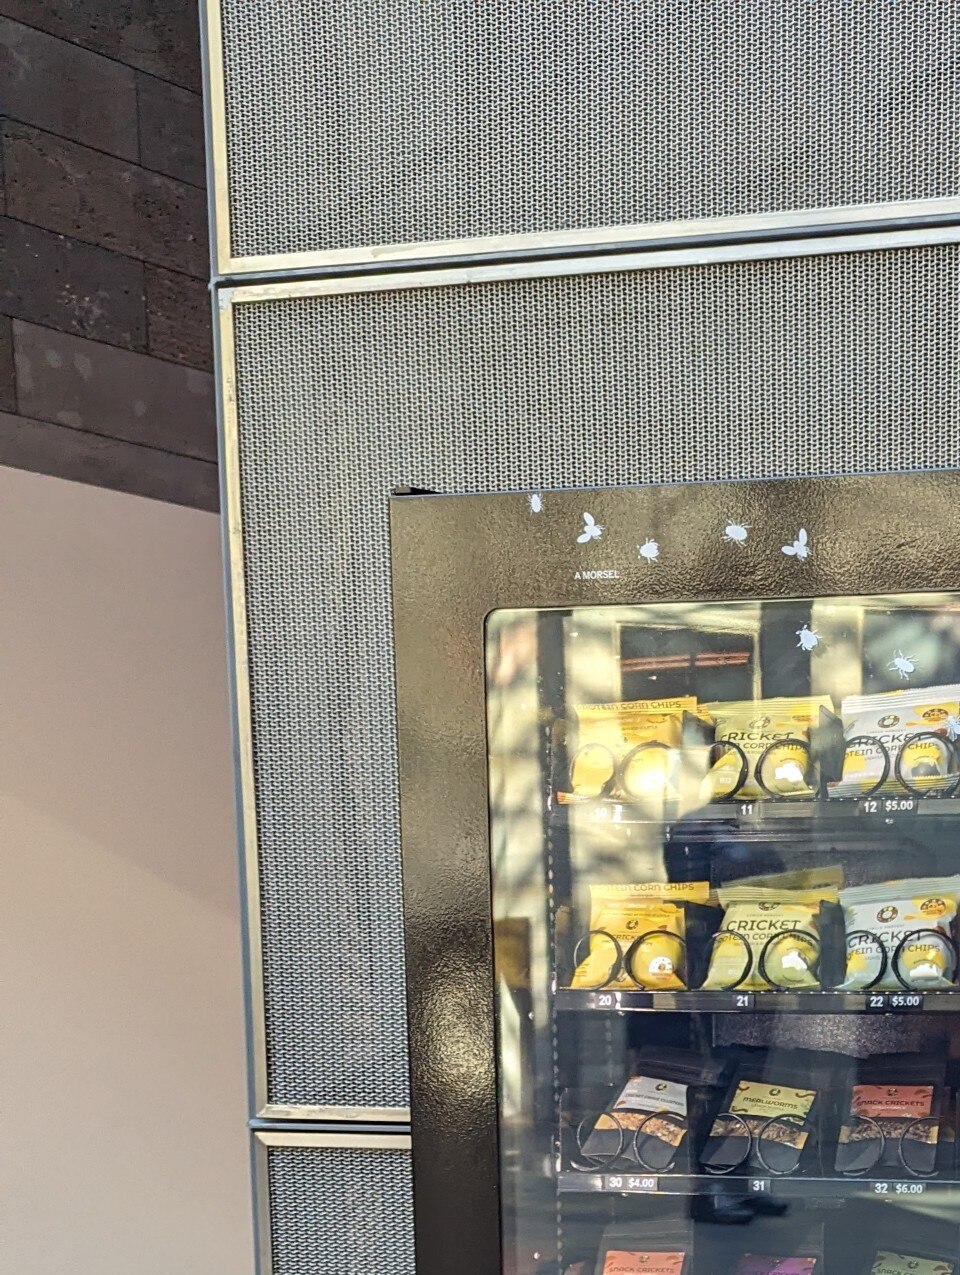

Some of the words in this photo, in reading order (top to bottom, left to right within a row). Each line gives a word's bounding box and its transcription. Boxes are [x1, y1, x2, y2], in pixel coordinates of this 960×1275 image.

[574, 571, 581, 580] A
[582, 570, 620, 580] MORSEL
[651, 700, 681, 709] CHIPS
[740, 804, 753, 815] 11
[864, 801, 877, 813] 12
[885, 800, 914, 812] $5.00
[663, 883, 694, 891] CHIPS
[726, 920, 801, 932] CRICKET
[907, 944, 940, 952] CHIPS
[599, 995, 612, 1006] 20
[736, 995, 749, 1006] 21
[870, 996, 884, 1007] 22
[892, 995, 920, 1007] $5.00
[742, 1097, 798, 1110] MEALWORMS
[609, 1177, 622, 1188] 30
[628, 1178, 654, 1188] $4.00
[752, 1181, 765, 1191] 31
[874, 1183, 888, 1194] 32
[896, 1184, 923, 1194] $6.00
